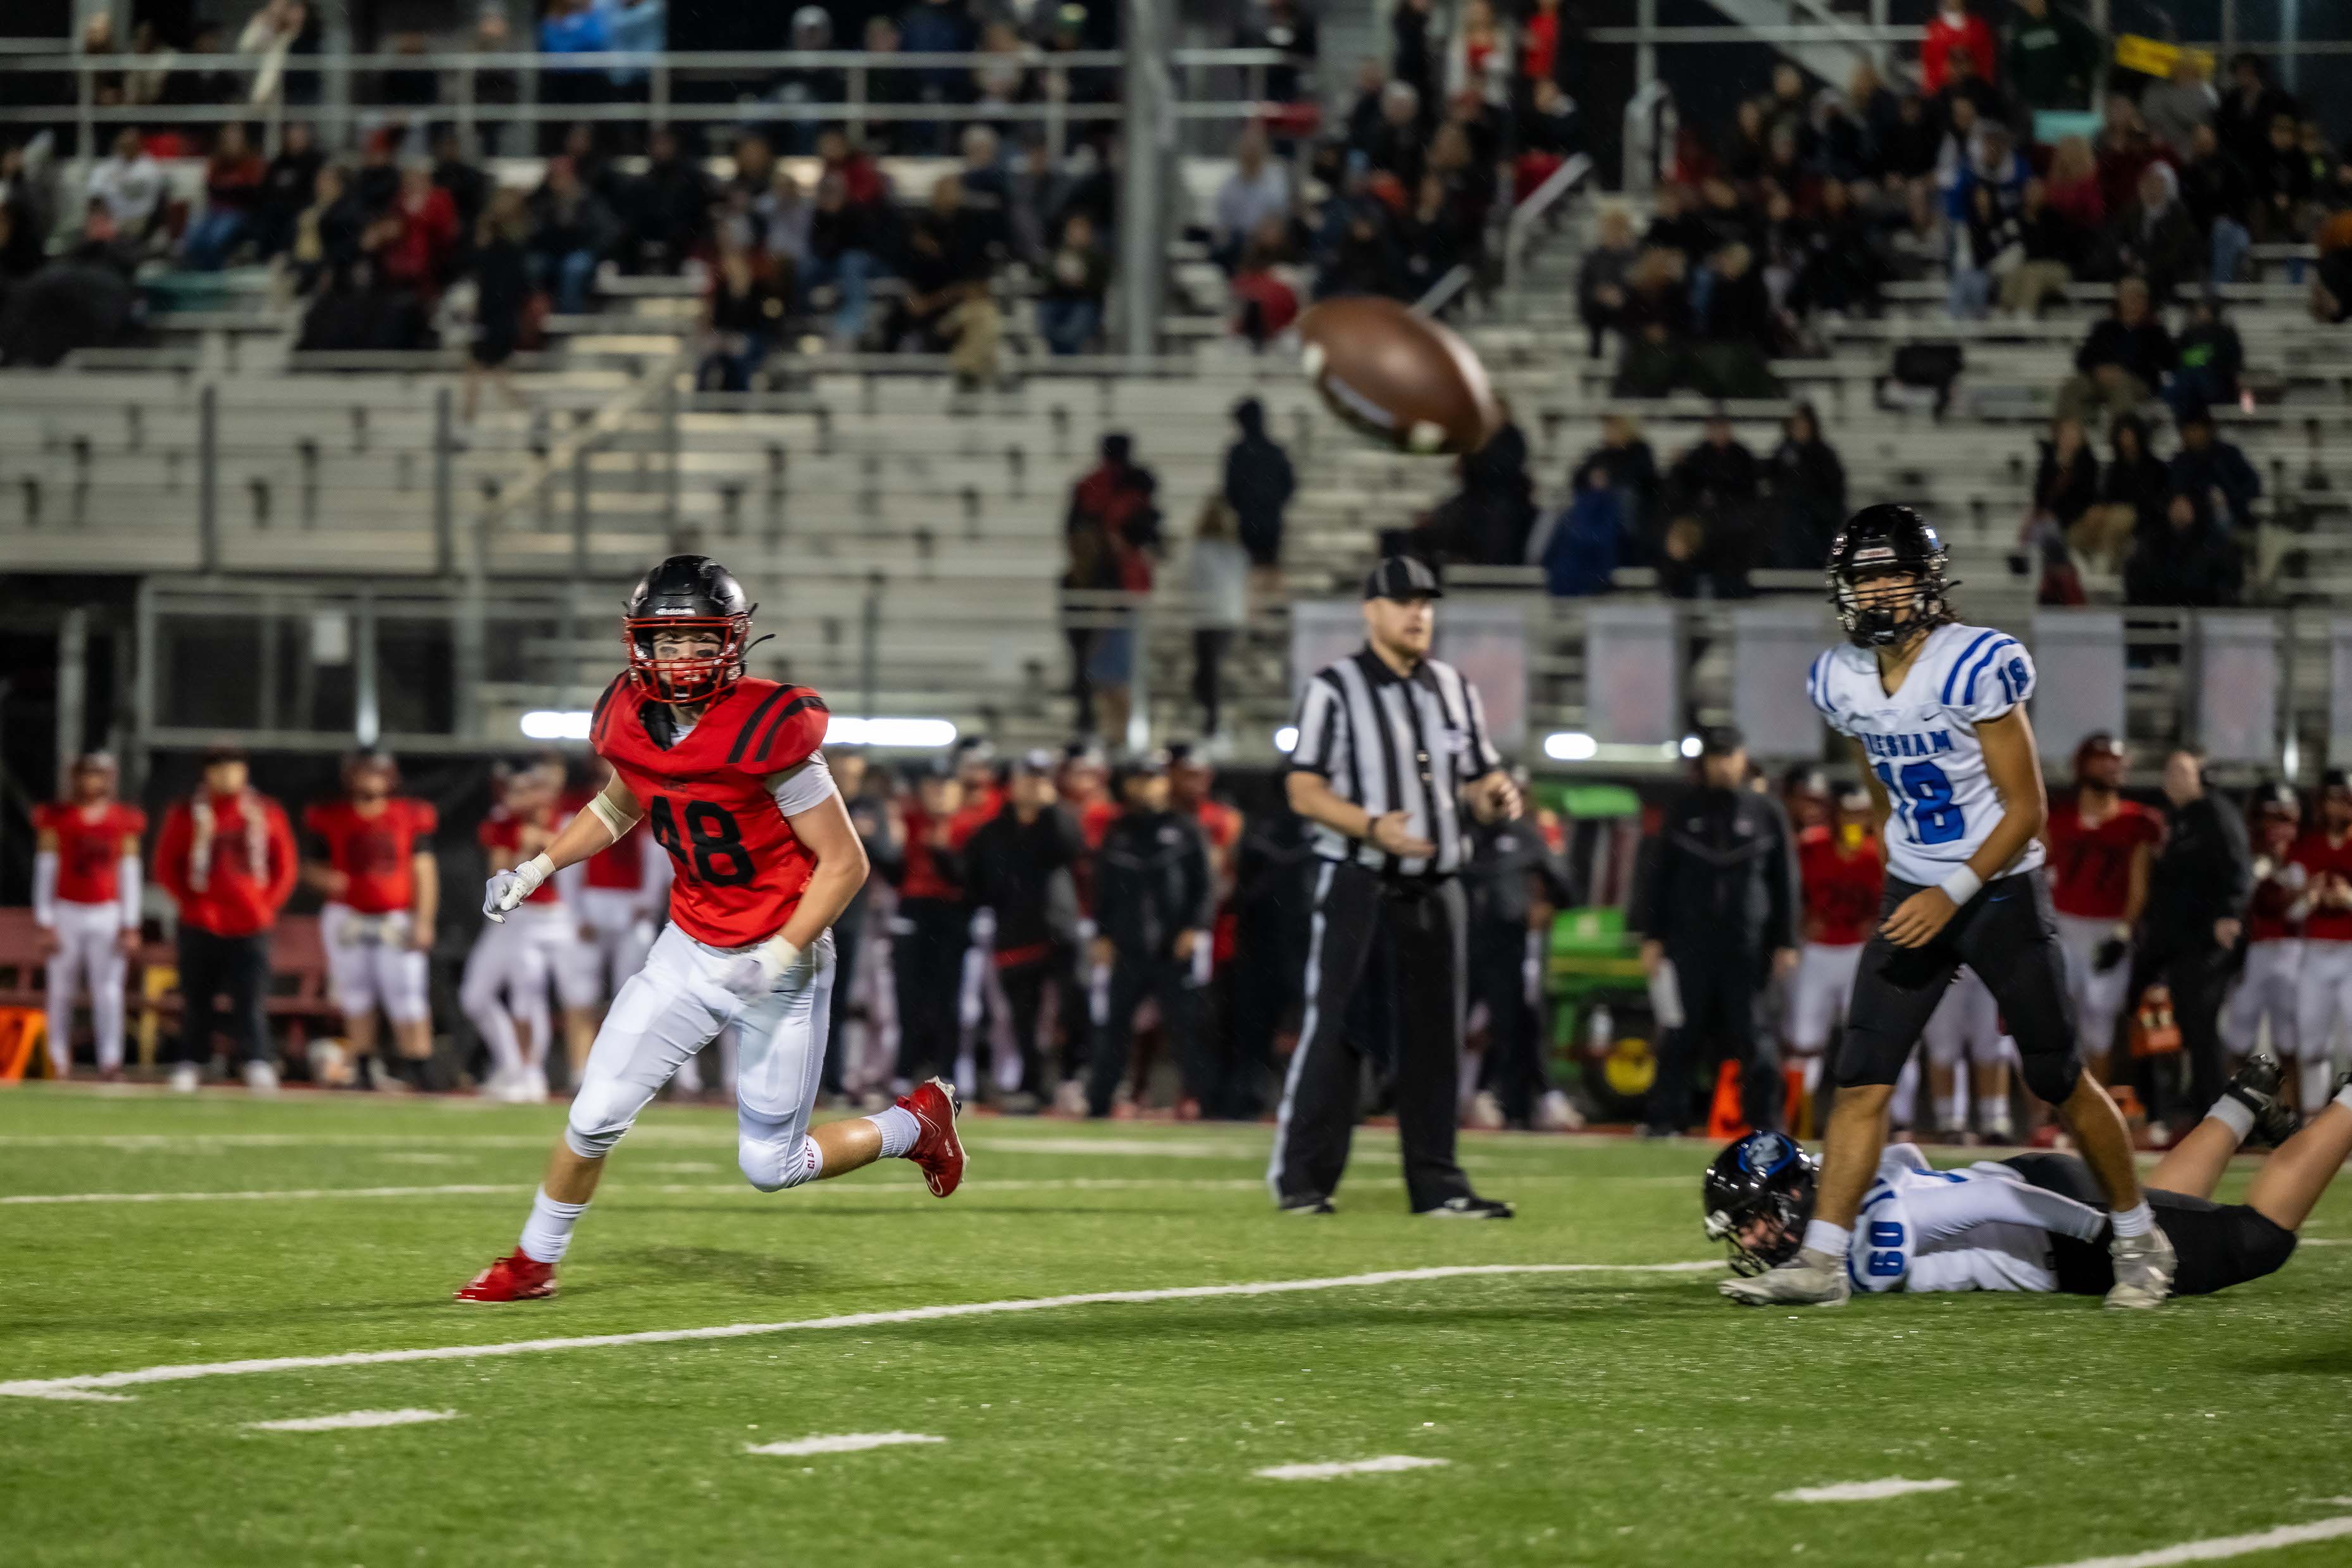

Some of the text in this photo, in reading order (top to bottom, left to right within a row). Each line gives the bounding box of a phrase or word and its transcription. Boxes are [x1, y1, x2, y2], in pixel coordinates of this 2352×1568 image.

[1997, 657, 2030, 704] 18
[1876, 761, 1964, 845] 18
[651, 795, 756, 887] 48
[1869, 1221, 1904, 1276] 60
